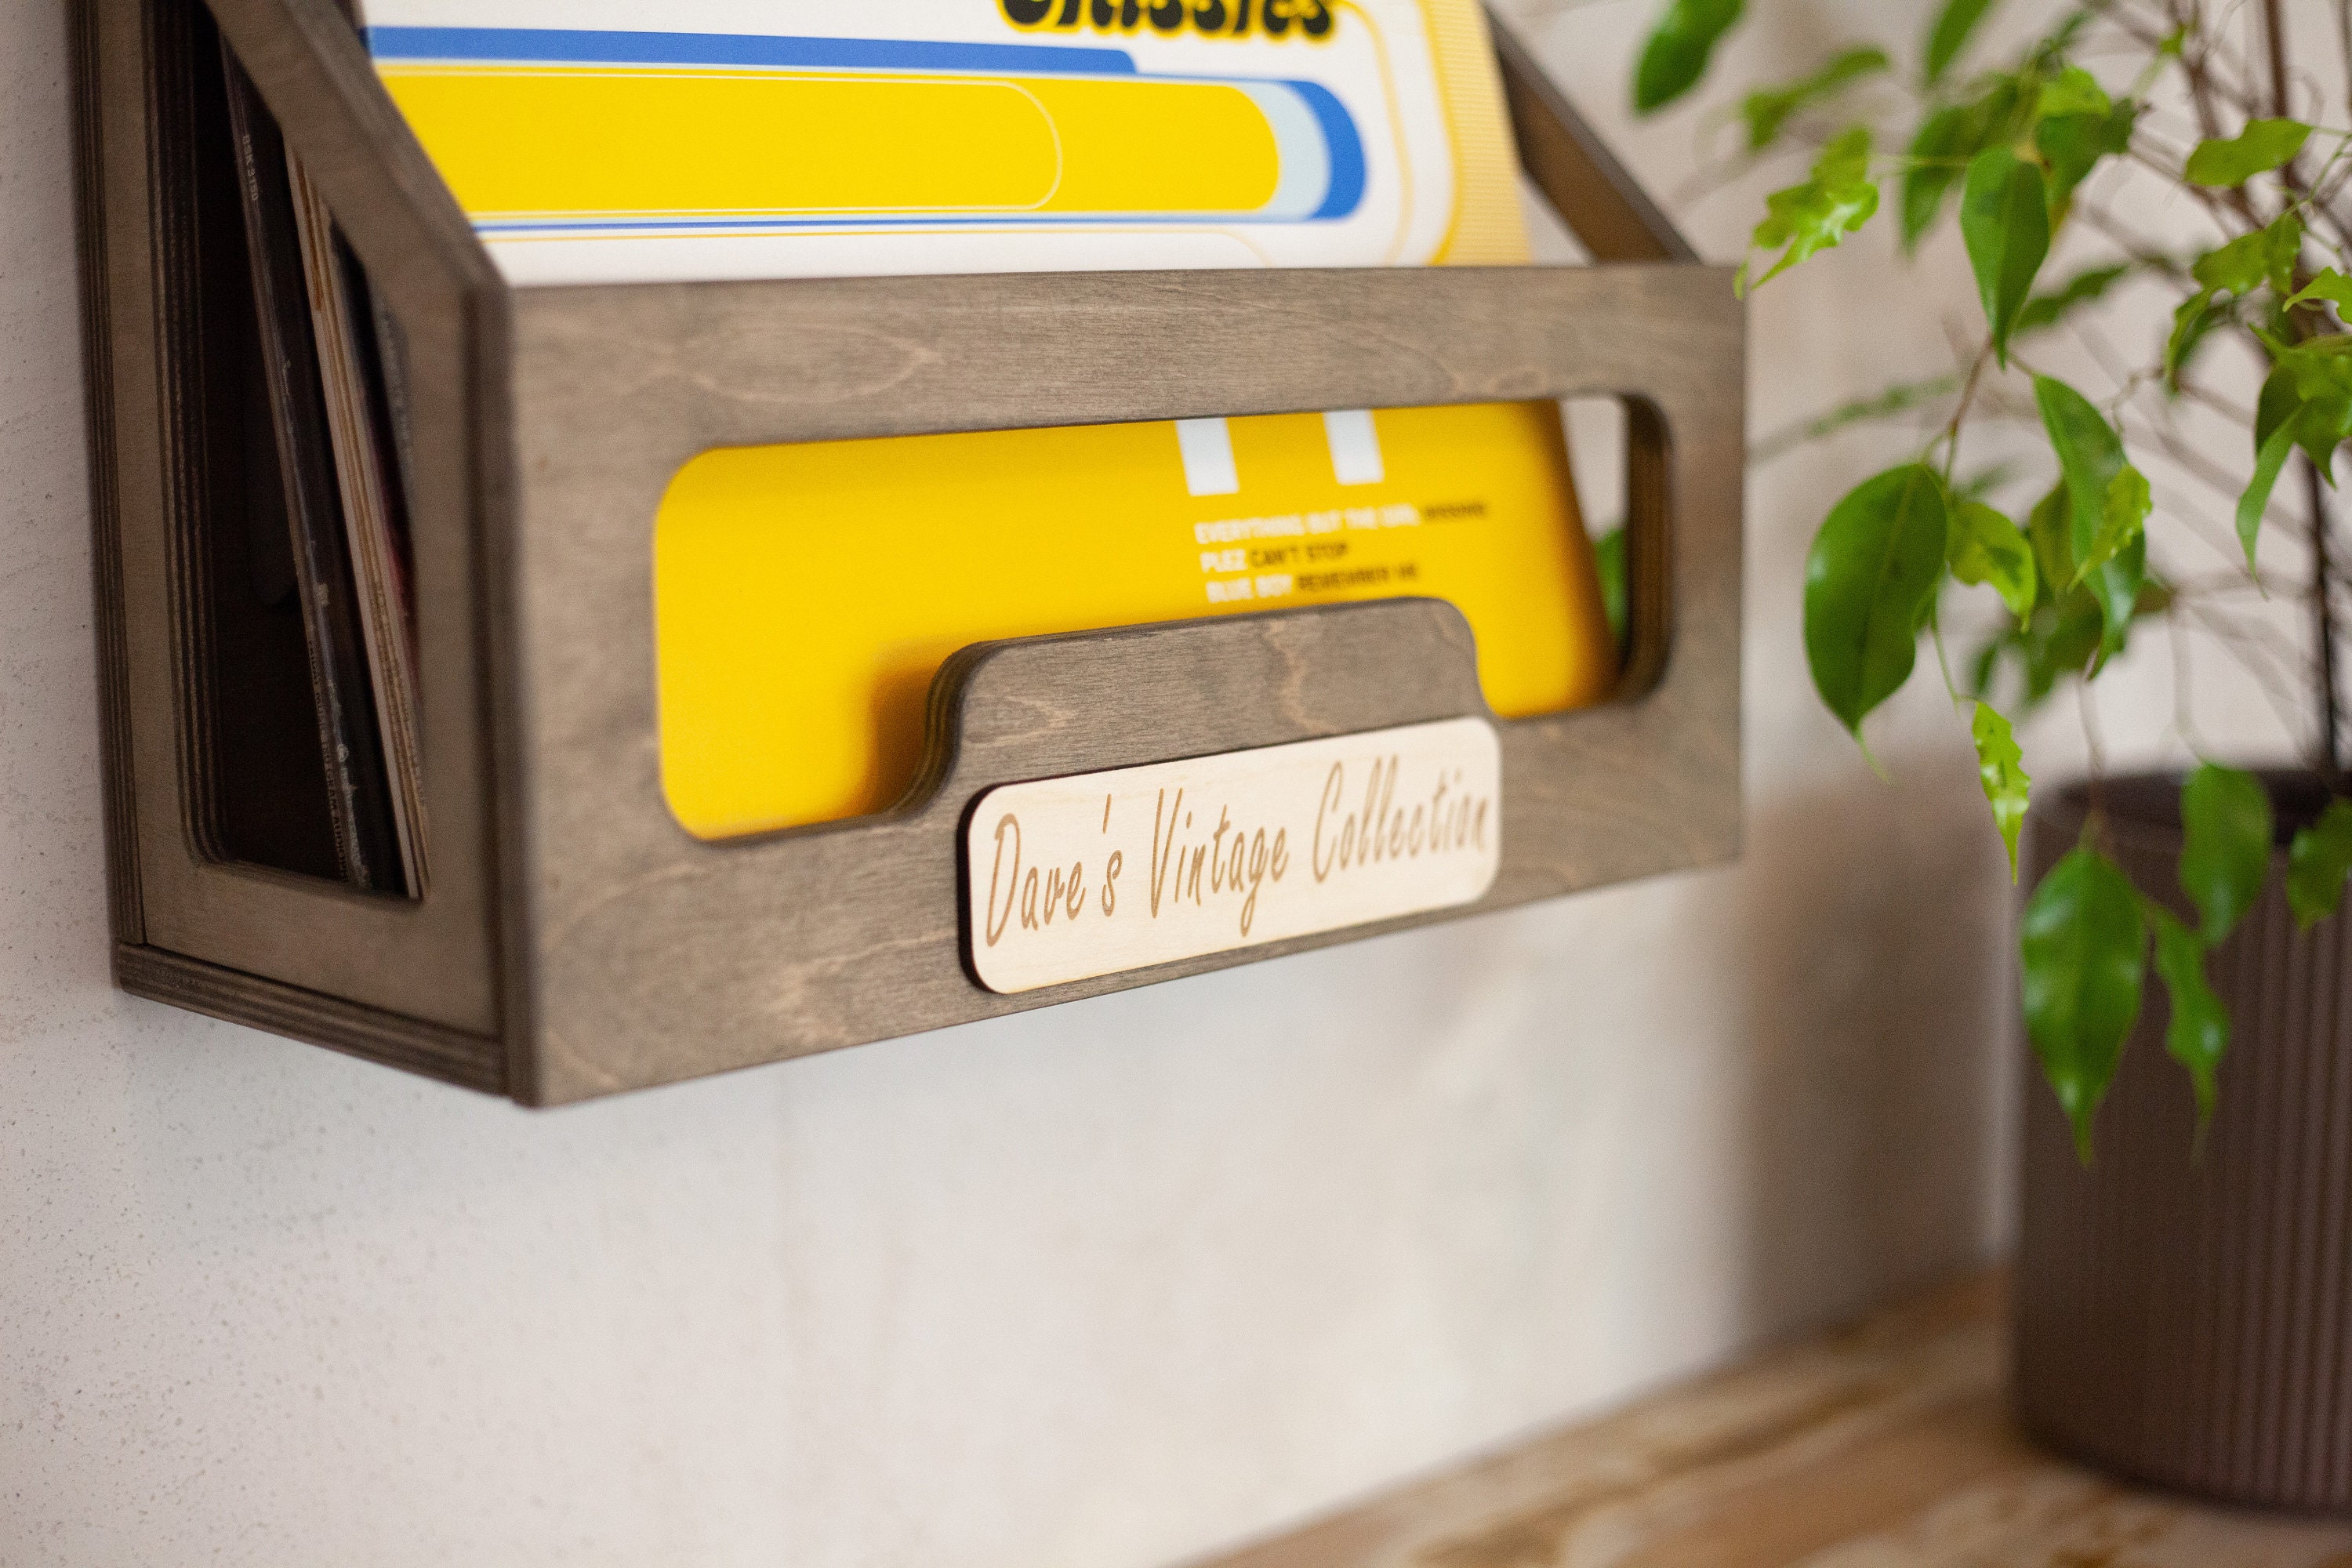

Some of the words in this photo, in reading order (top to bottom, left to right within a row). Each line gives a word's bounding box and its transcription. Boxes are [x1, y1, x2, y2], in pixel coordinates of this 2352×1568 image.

[1193, 513, 1305, 545] EVERYTHING
[1305, 509, 1343, 535] BUT
[1344, 506, 1378, 531] THE
[1250, 543, 1298, 568] CAN'T
[1305, 539, 1349, 563] STOP
[1296, 564, 1391, 591] REMEMBER
[325, 768, 338, 810] GRAM
[985, 793, 1124, 948] Dave's
[1150, 786, 1290, 938] Vintage
[1312, 754, 1490, 884] Collection
